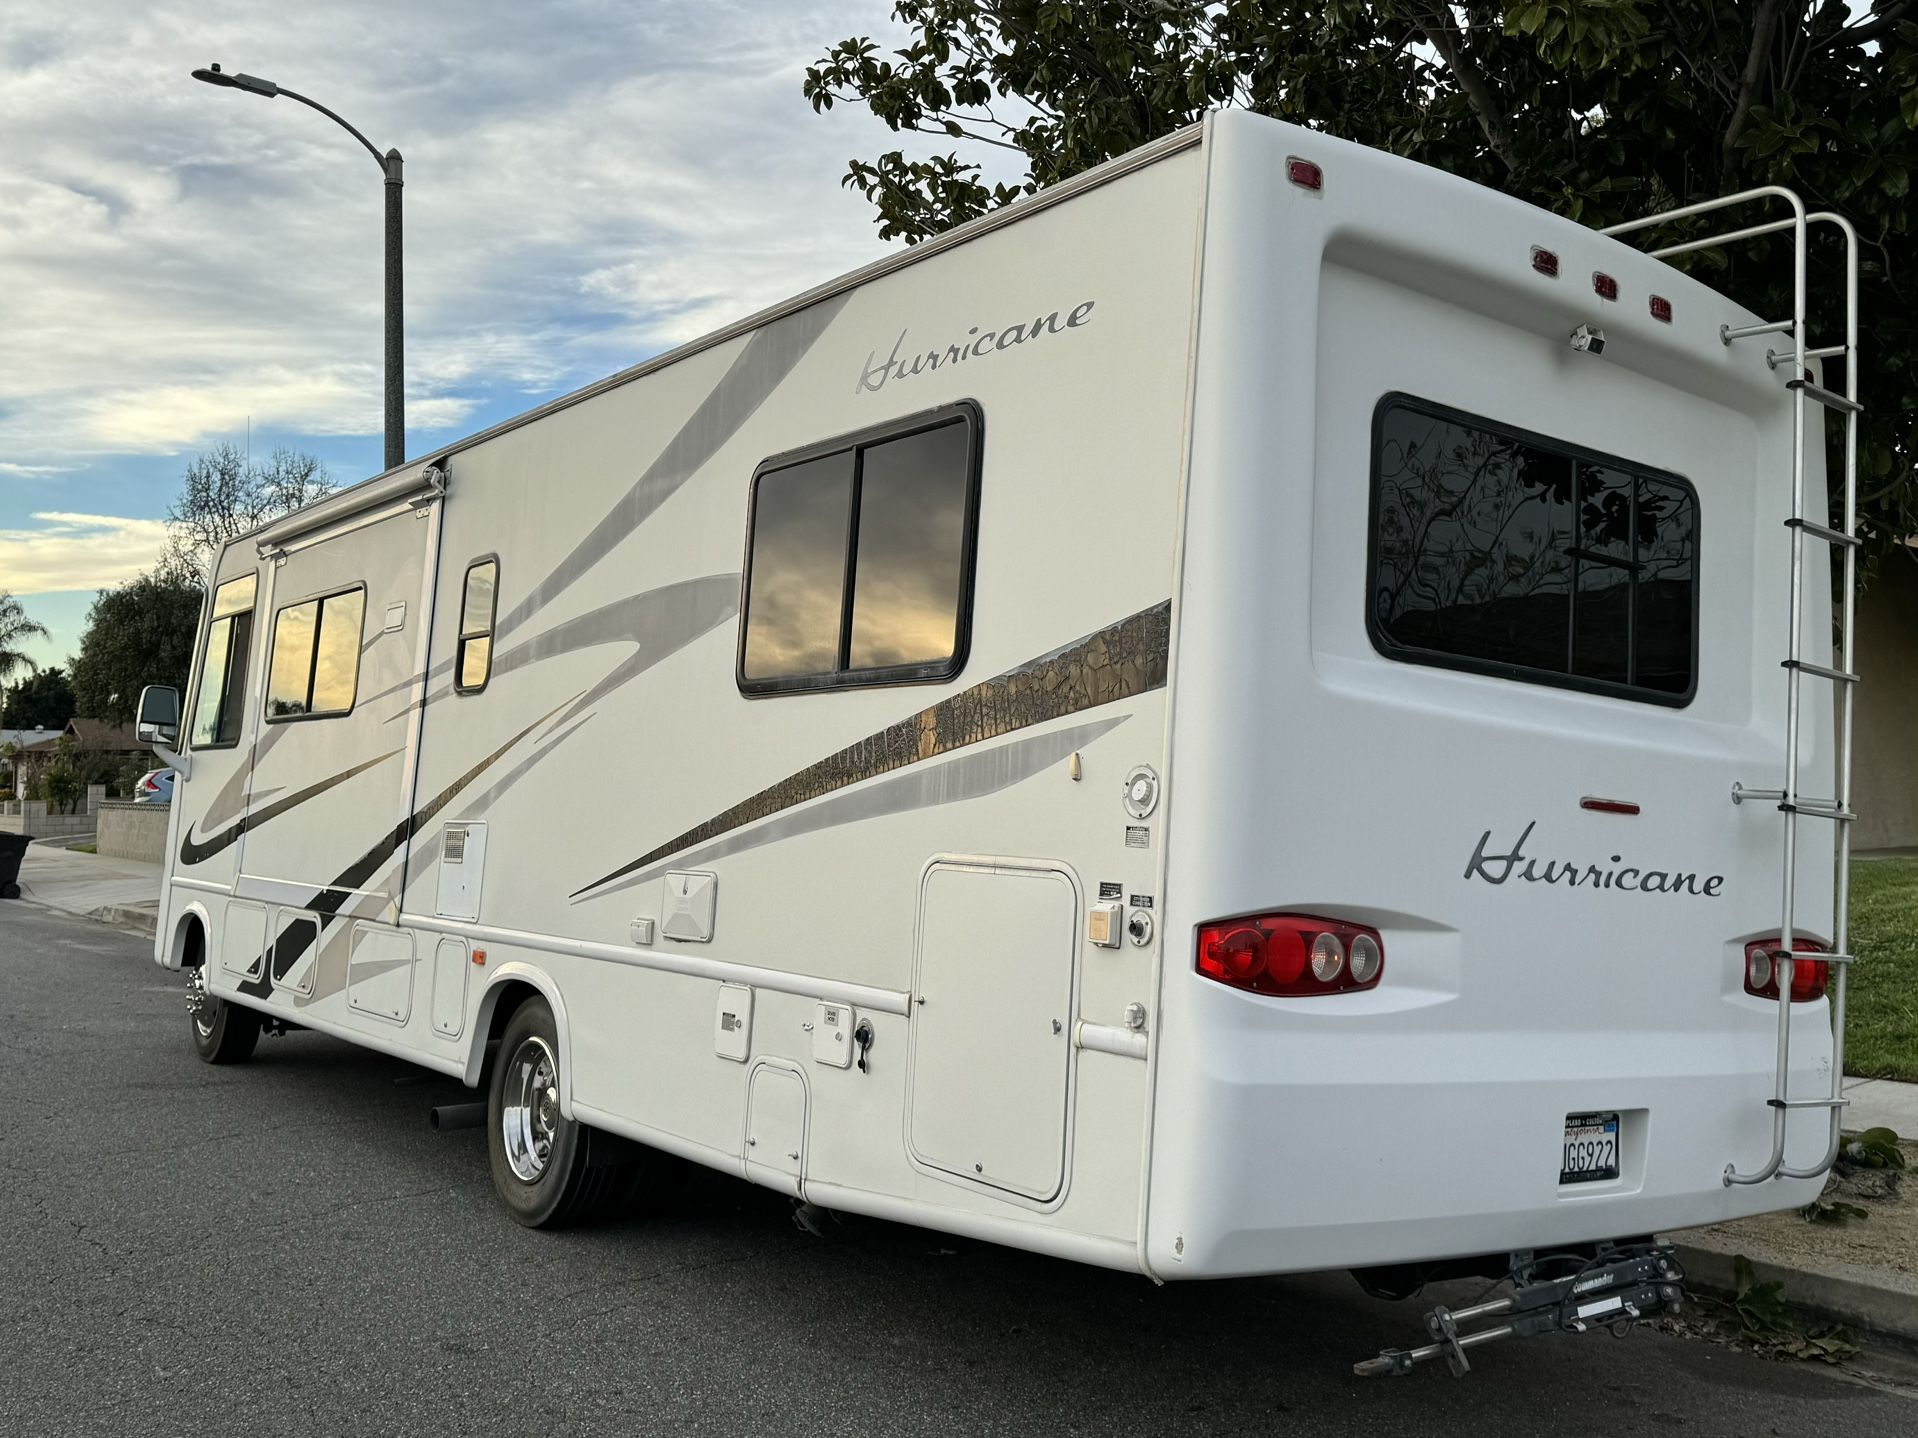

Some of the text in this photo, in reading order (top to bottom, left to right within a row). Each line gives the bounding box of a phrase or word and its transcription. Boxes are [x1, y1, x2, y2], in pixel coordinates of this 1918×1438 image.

[855, 301, 1095, 394] Hurricane
[1463, 820, 1724, 897] Hurricane
[1564, 1126, 1605, 1141] alifornia
[1565, 1118, 1582, 1127] PLAND
